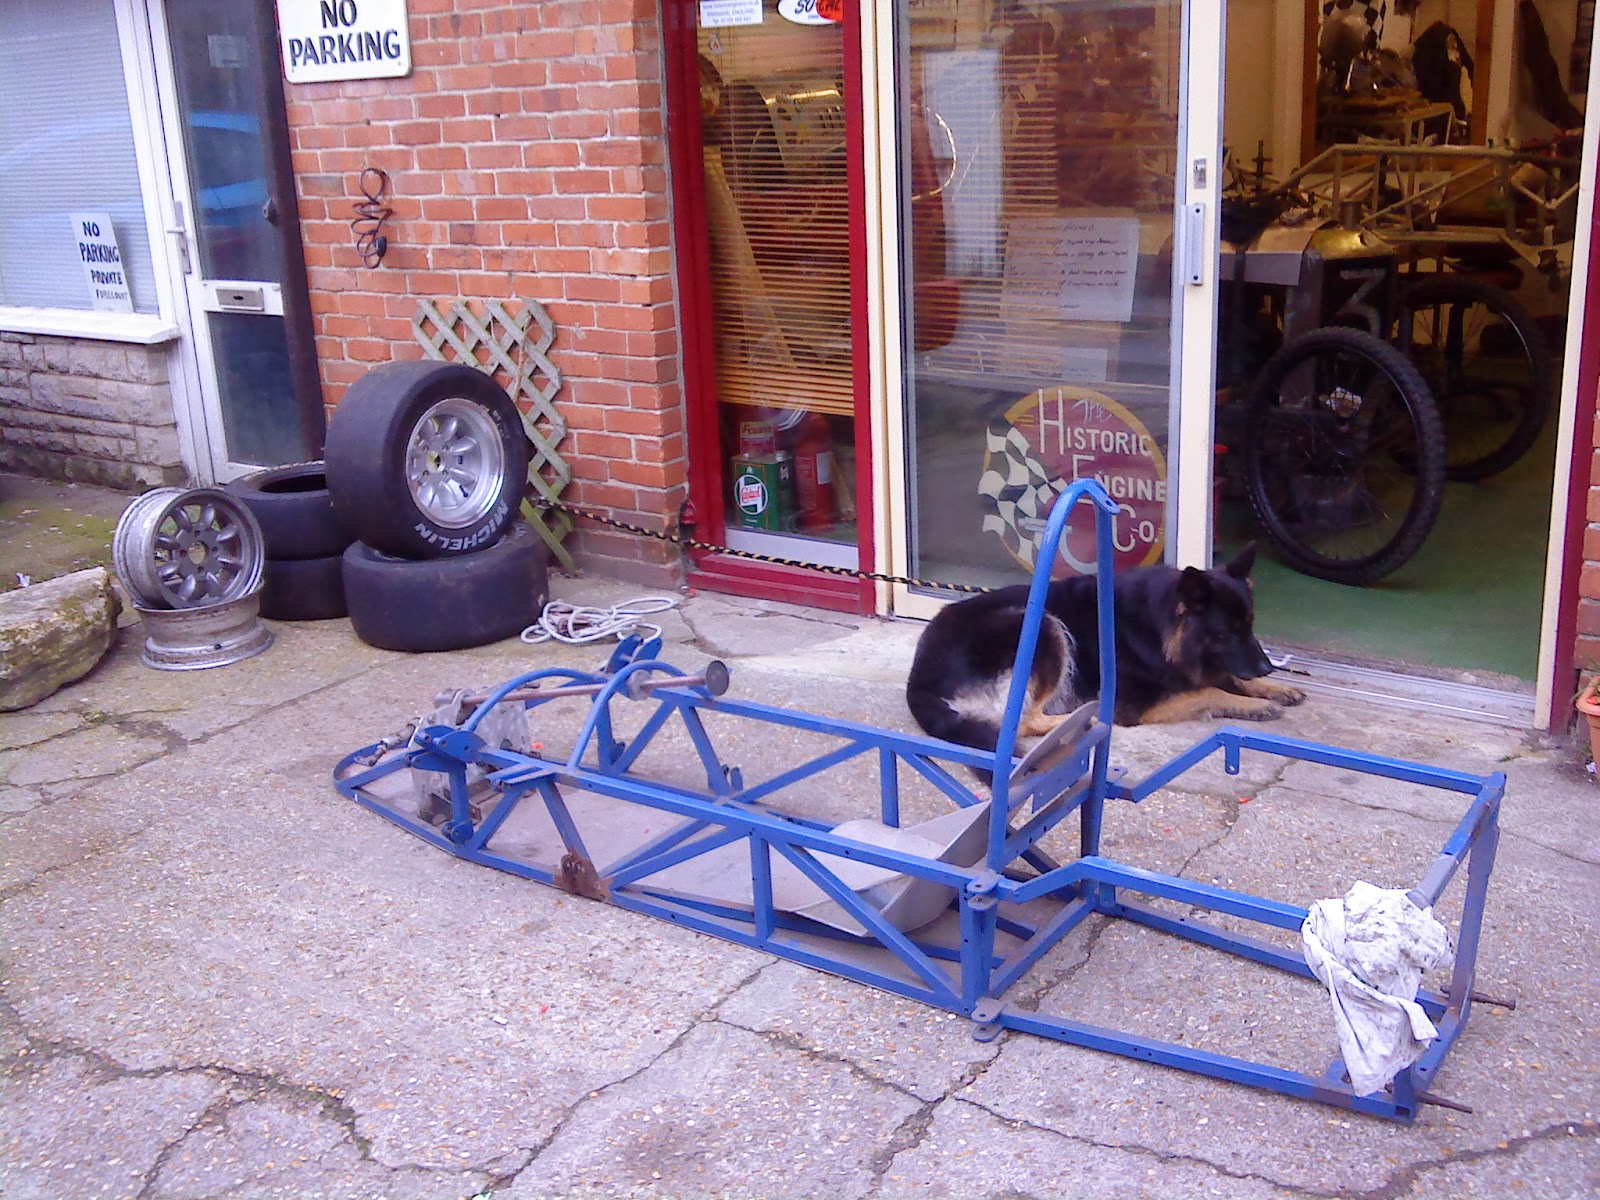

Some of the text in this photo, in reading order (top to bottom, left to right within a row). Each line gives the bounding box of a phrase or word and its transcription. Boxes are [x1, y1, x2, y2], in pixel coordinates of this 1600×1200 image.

[319, 0, 358, 28] NO
[288, 28, 401, 67] PARKING
[82, 221, 100, 237] NO
[79, 242, 120, 263] PARKING
[90, 269, 123, 286] PRIVATE
[413, 499, 509, 551] MICHELIN
